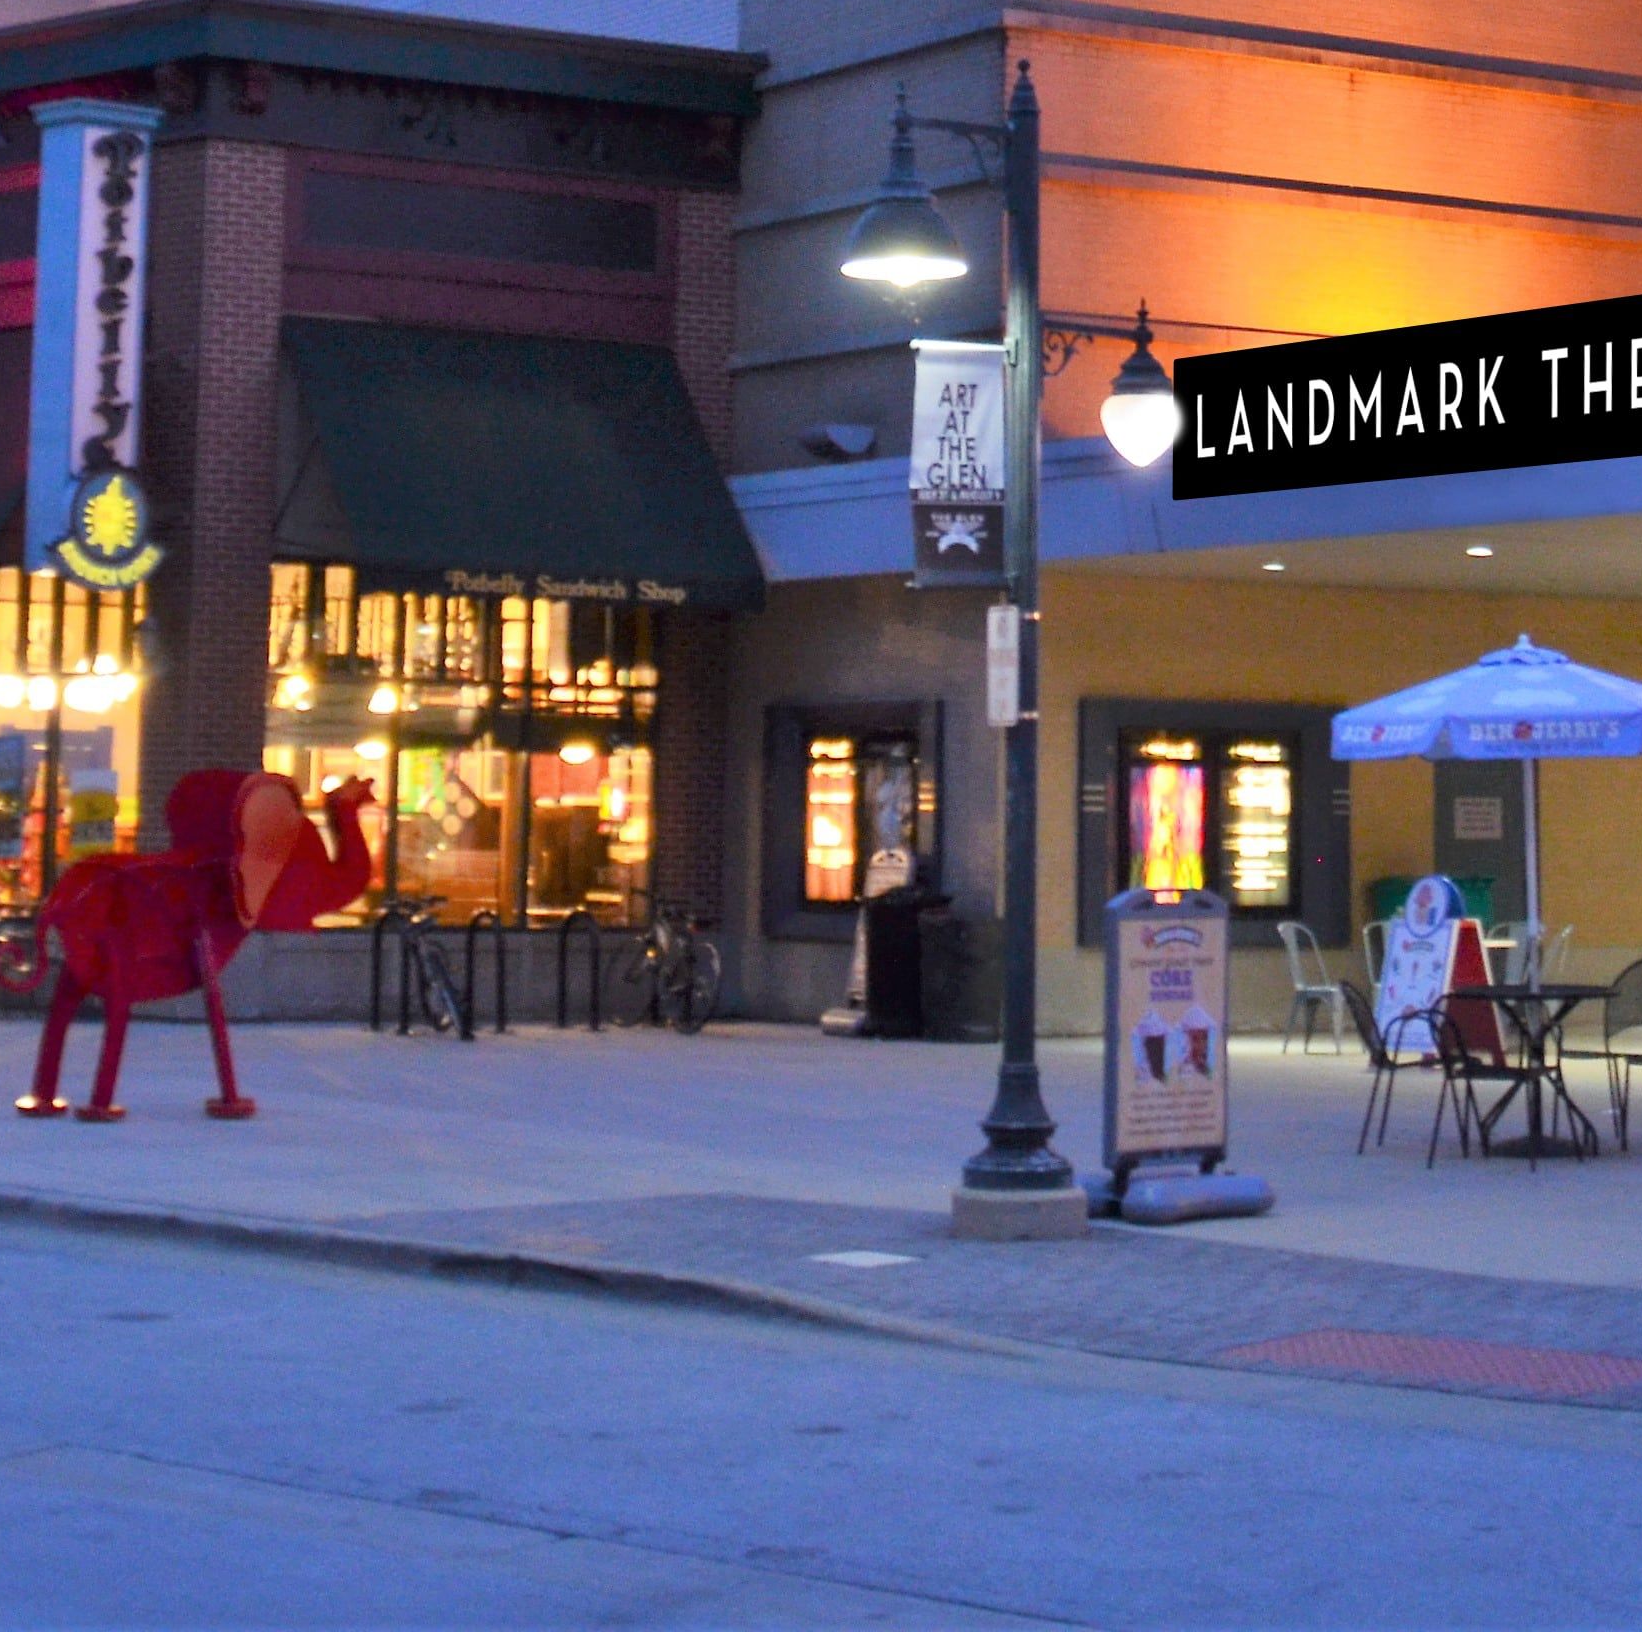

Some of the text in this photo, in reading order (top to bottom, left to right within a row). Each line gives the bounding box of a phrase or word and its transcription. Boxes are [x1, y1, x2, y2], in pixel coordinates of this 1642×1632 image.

[938, 383, 978, 408] ART
[1196, 355, 1506, 459] LANDMARK
[945, 410, 970, 435] AT
[938, 436, 976, 462] THE
[927, 462, 987, 490] GLEN
[536, 574, 627, 600] Sandwich
[638, 579, 687, 605] Shop
